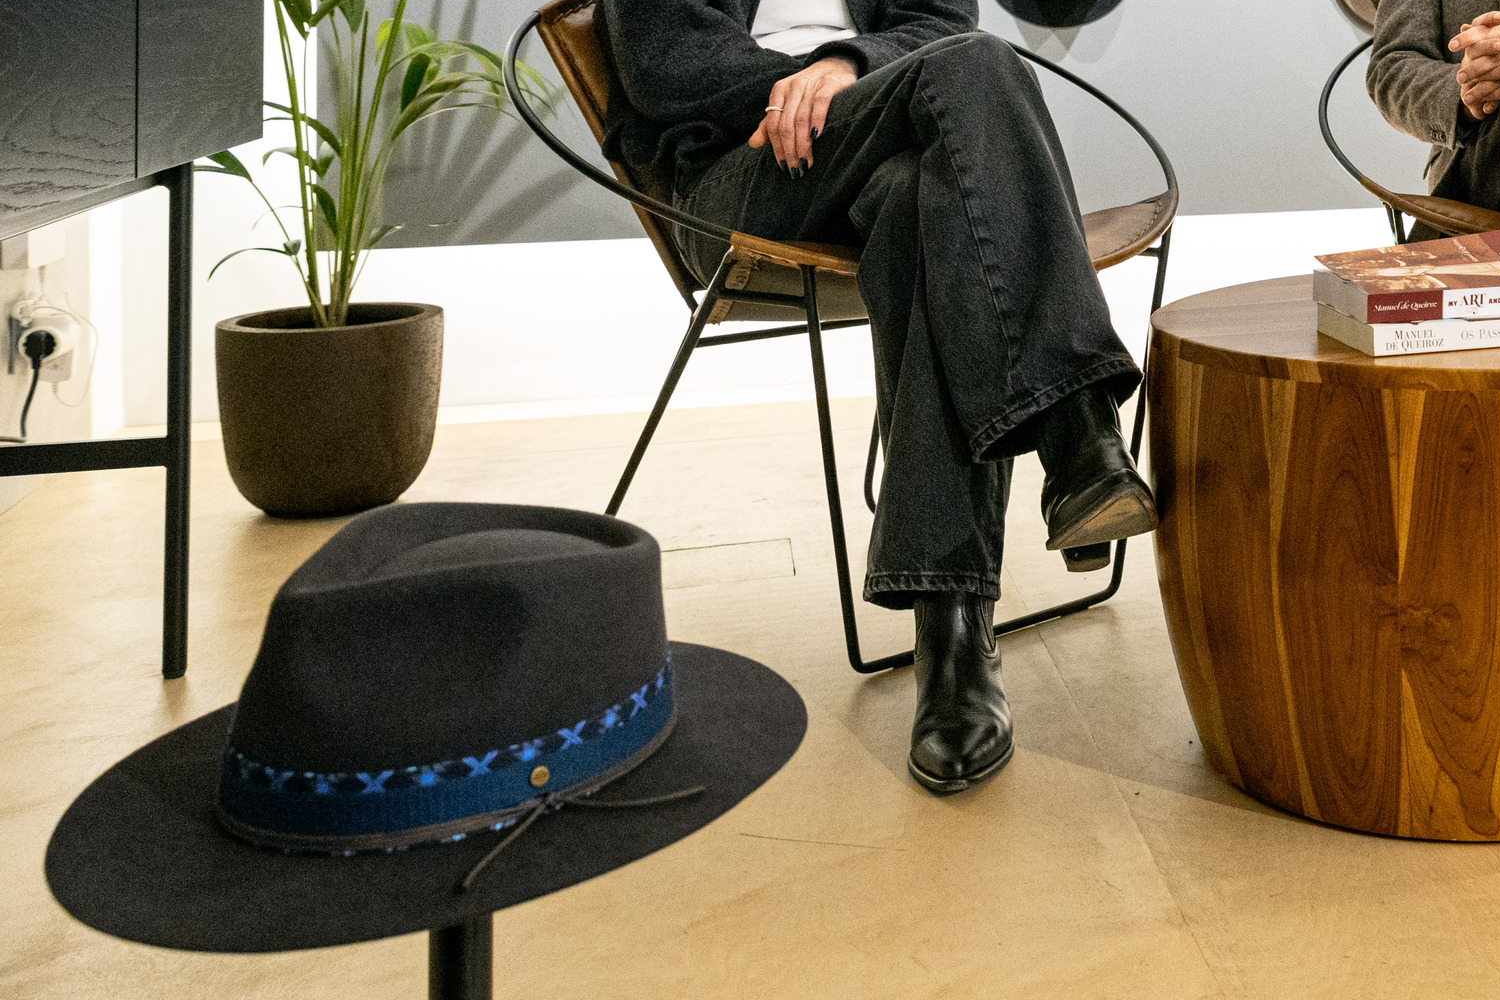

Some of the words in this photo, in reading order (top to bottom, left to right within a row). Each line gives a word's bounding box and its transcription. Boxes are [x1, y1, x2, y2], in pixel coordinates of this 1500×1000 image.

[1373, 301, 1402, 312] Manuel
[1401, 300, 1410, 310] de
[1410, 301, 1438, 311] Queiroz
[1460, 293, 1487, 308] ART
[1385, 341, 1399, 351] DE
